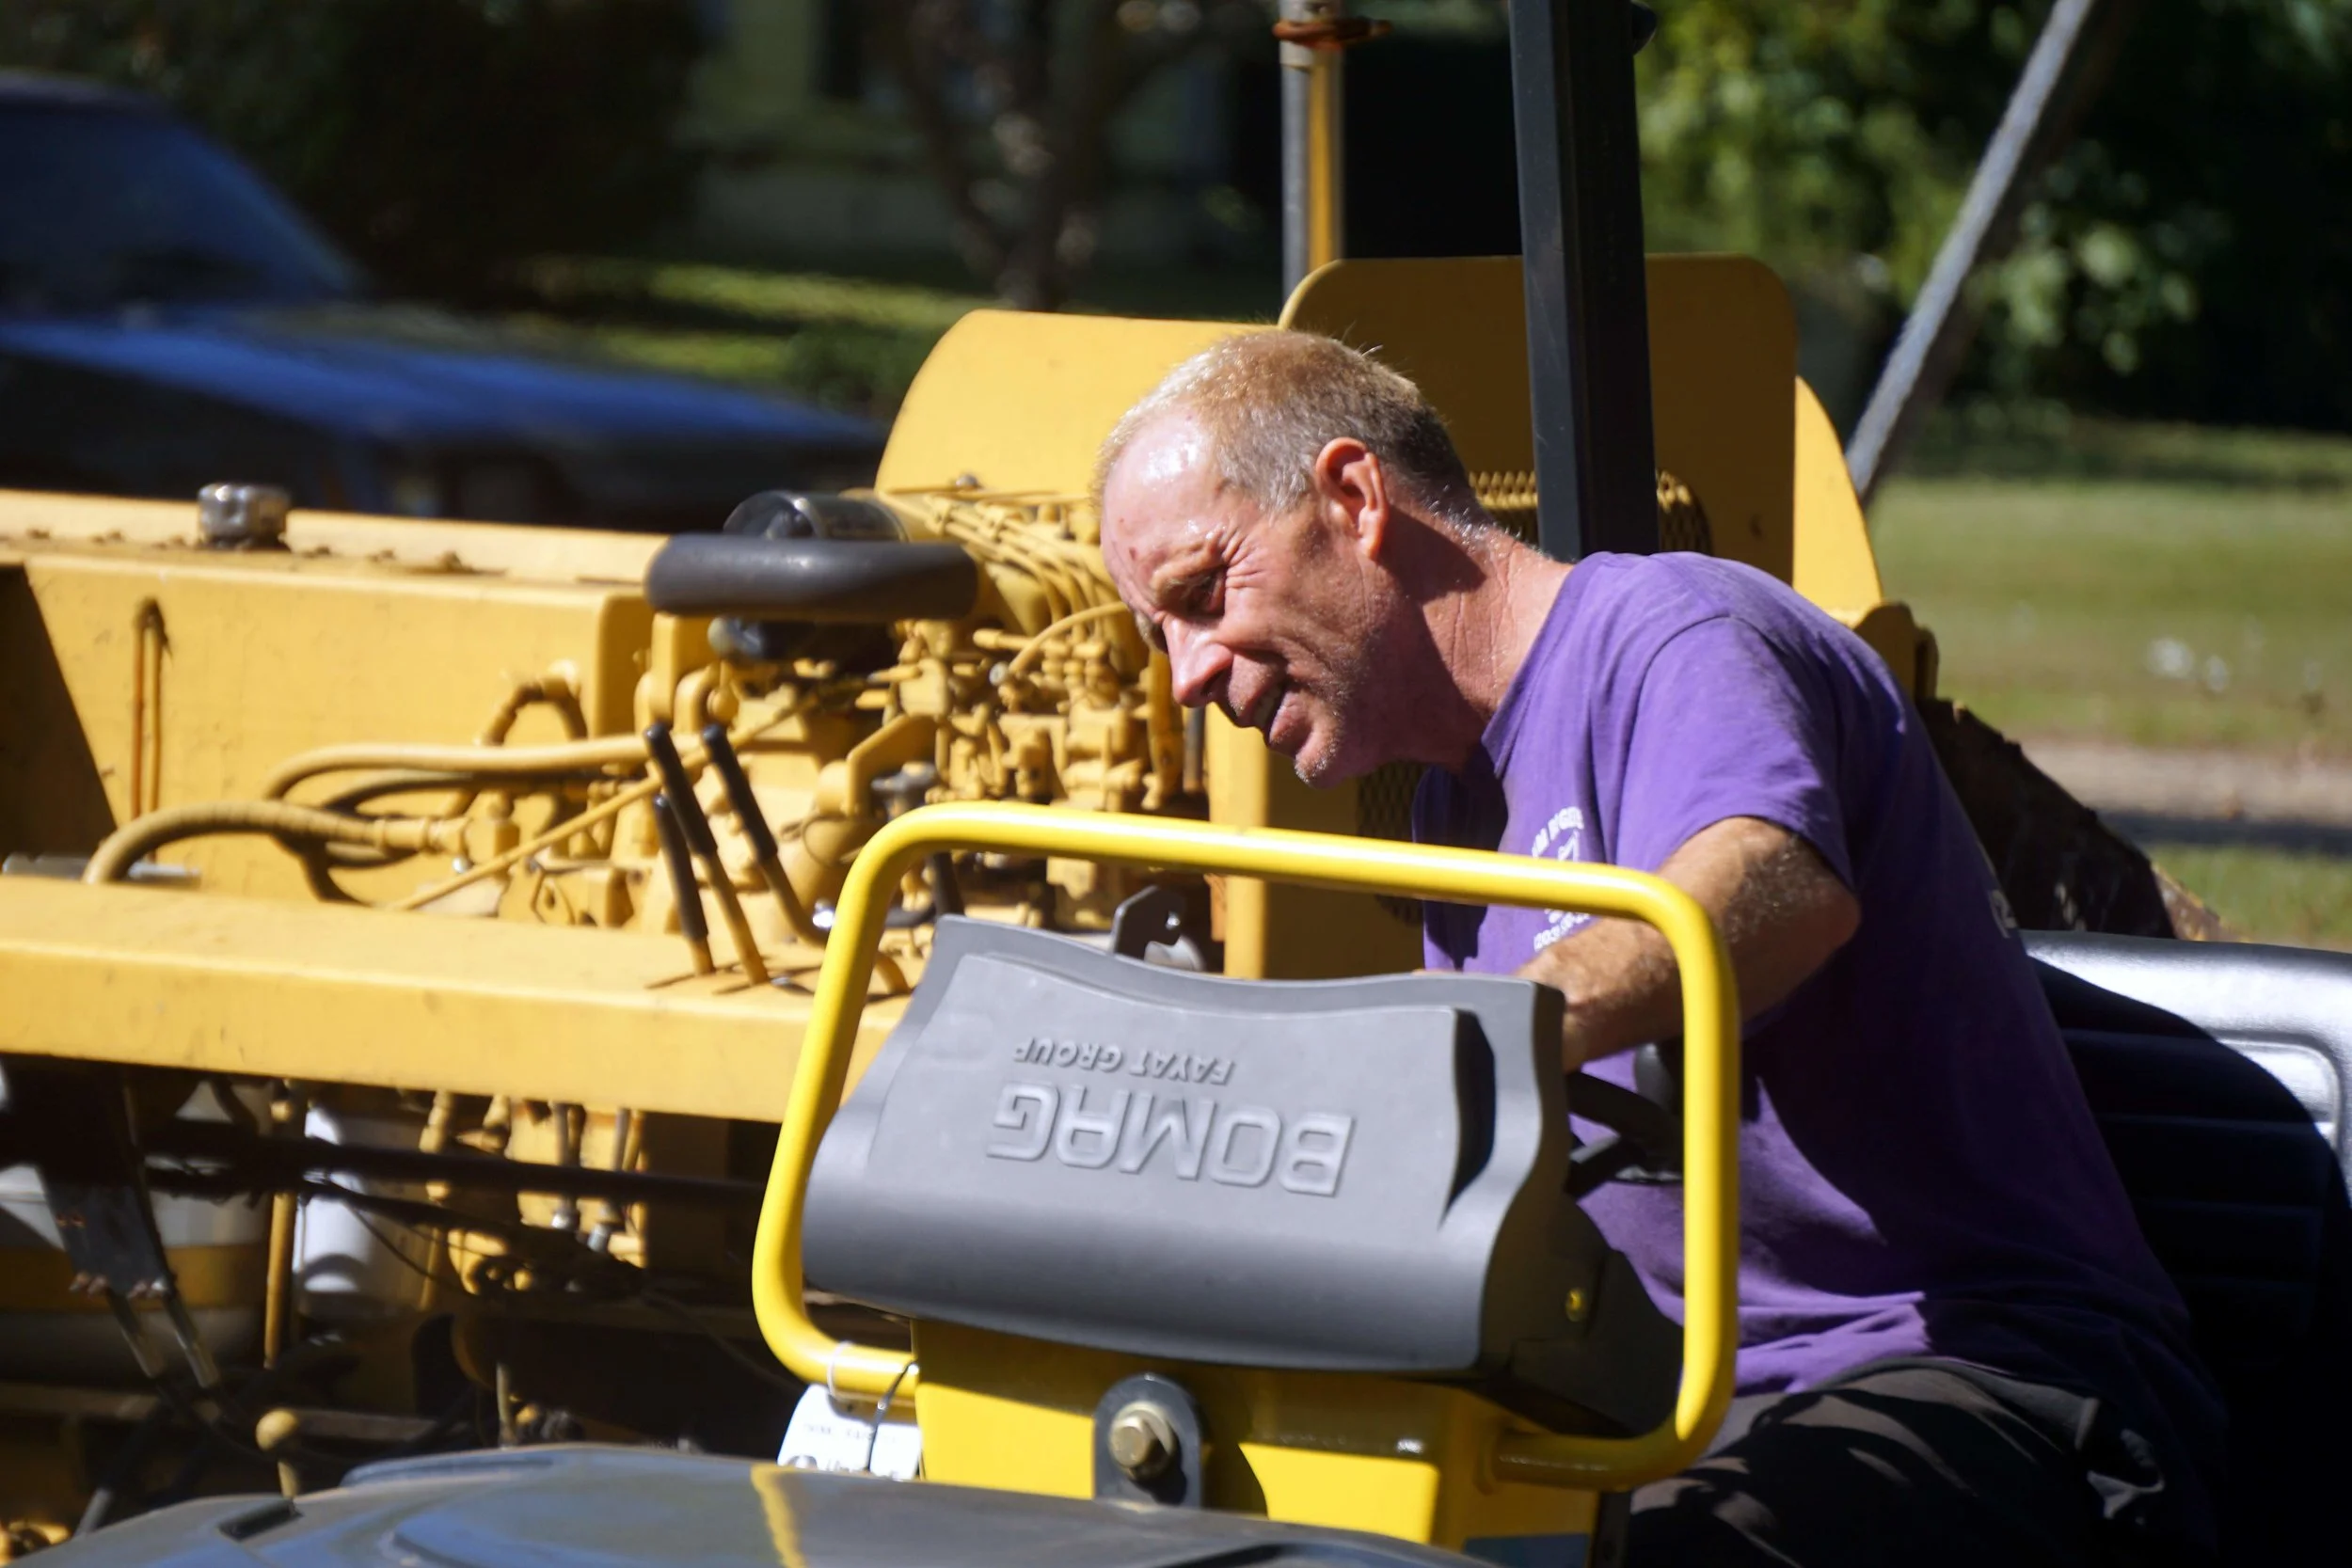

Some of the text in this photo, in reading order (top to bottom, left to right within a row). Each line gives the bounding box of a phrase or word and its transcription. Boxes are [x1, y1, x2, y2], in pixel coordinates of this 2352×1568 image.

[1012, 1037, 1235, 1085] FAYAT GROUP
[986, 1083, 1355, 1196] BOMAG
